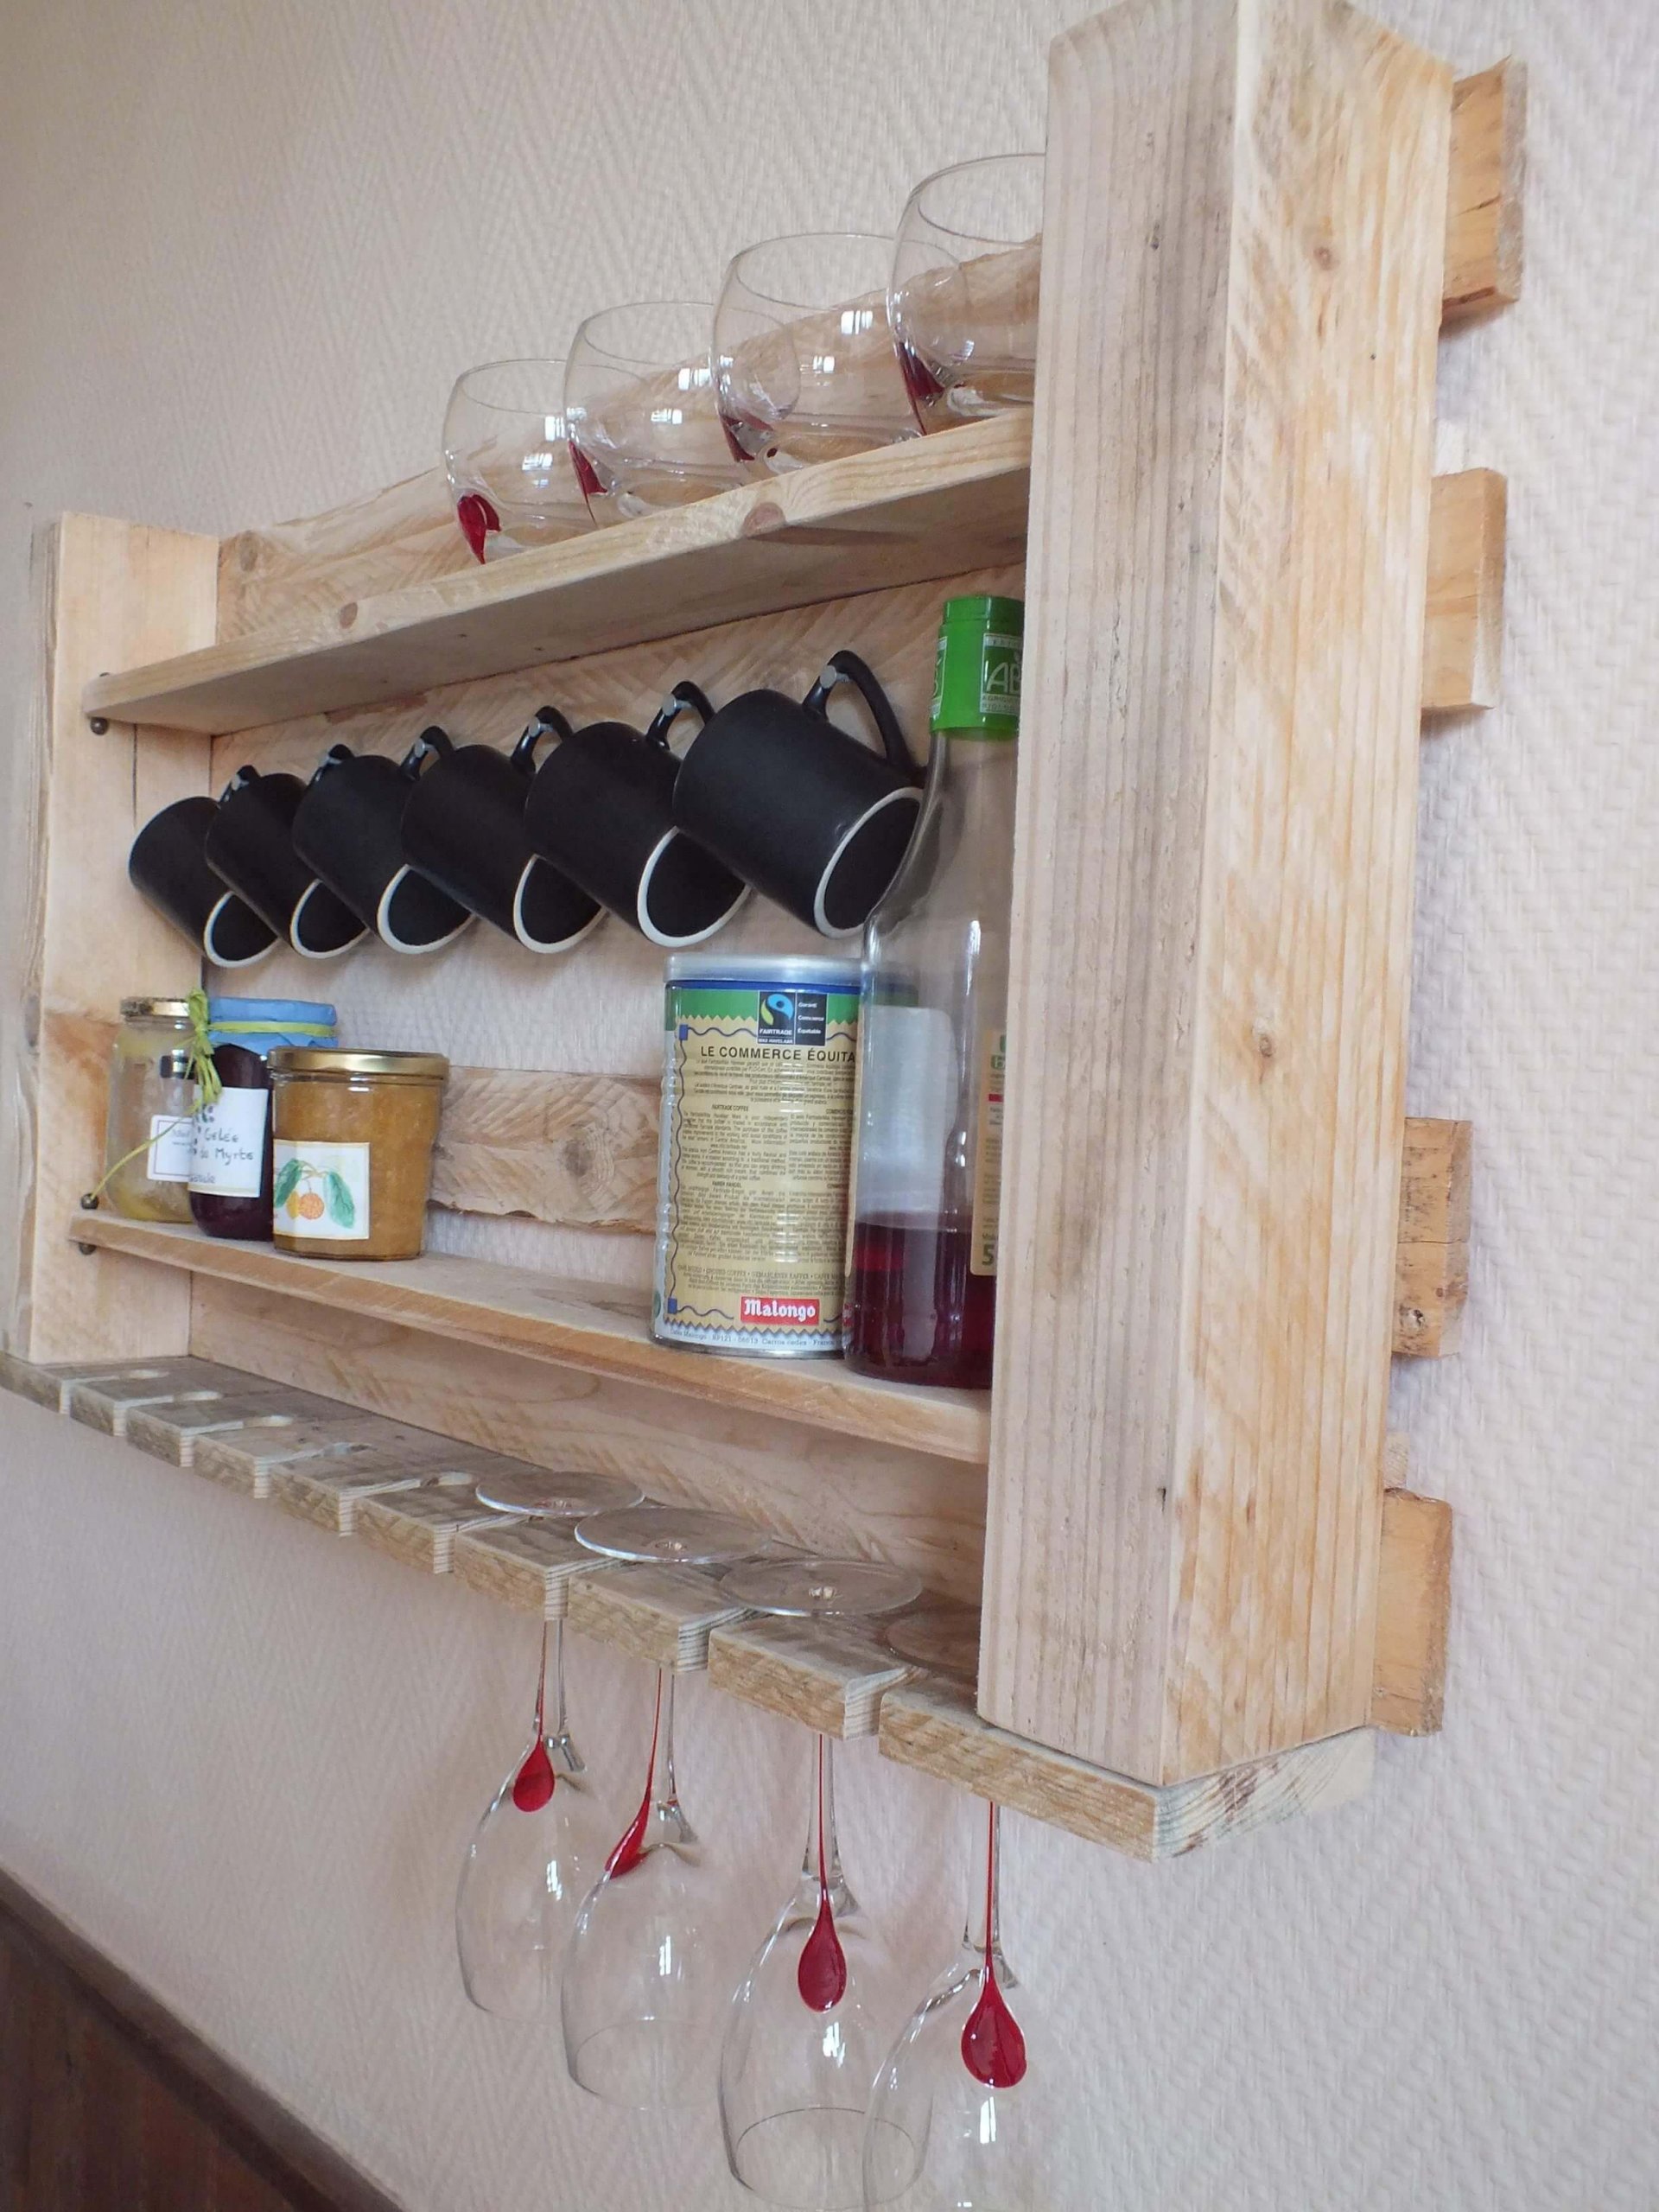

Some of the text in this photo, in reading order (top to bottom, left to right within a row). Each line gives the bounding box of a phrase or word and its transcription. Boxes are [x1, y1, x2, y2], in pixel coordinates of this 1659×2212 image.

[701, 1046, 715, 1057] LE
[719, 1046, 802, 1060] COMMERCE
[744, 1298, 816, 1323] Malongo
